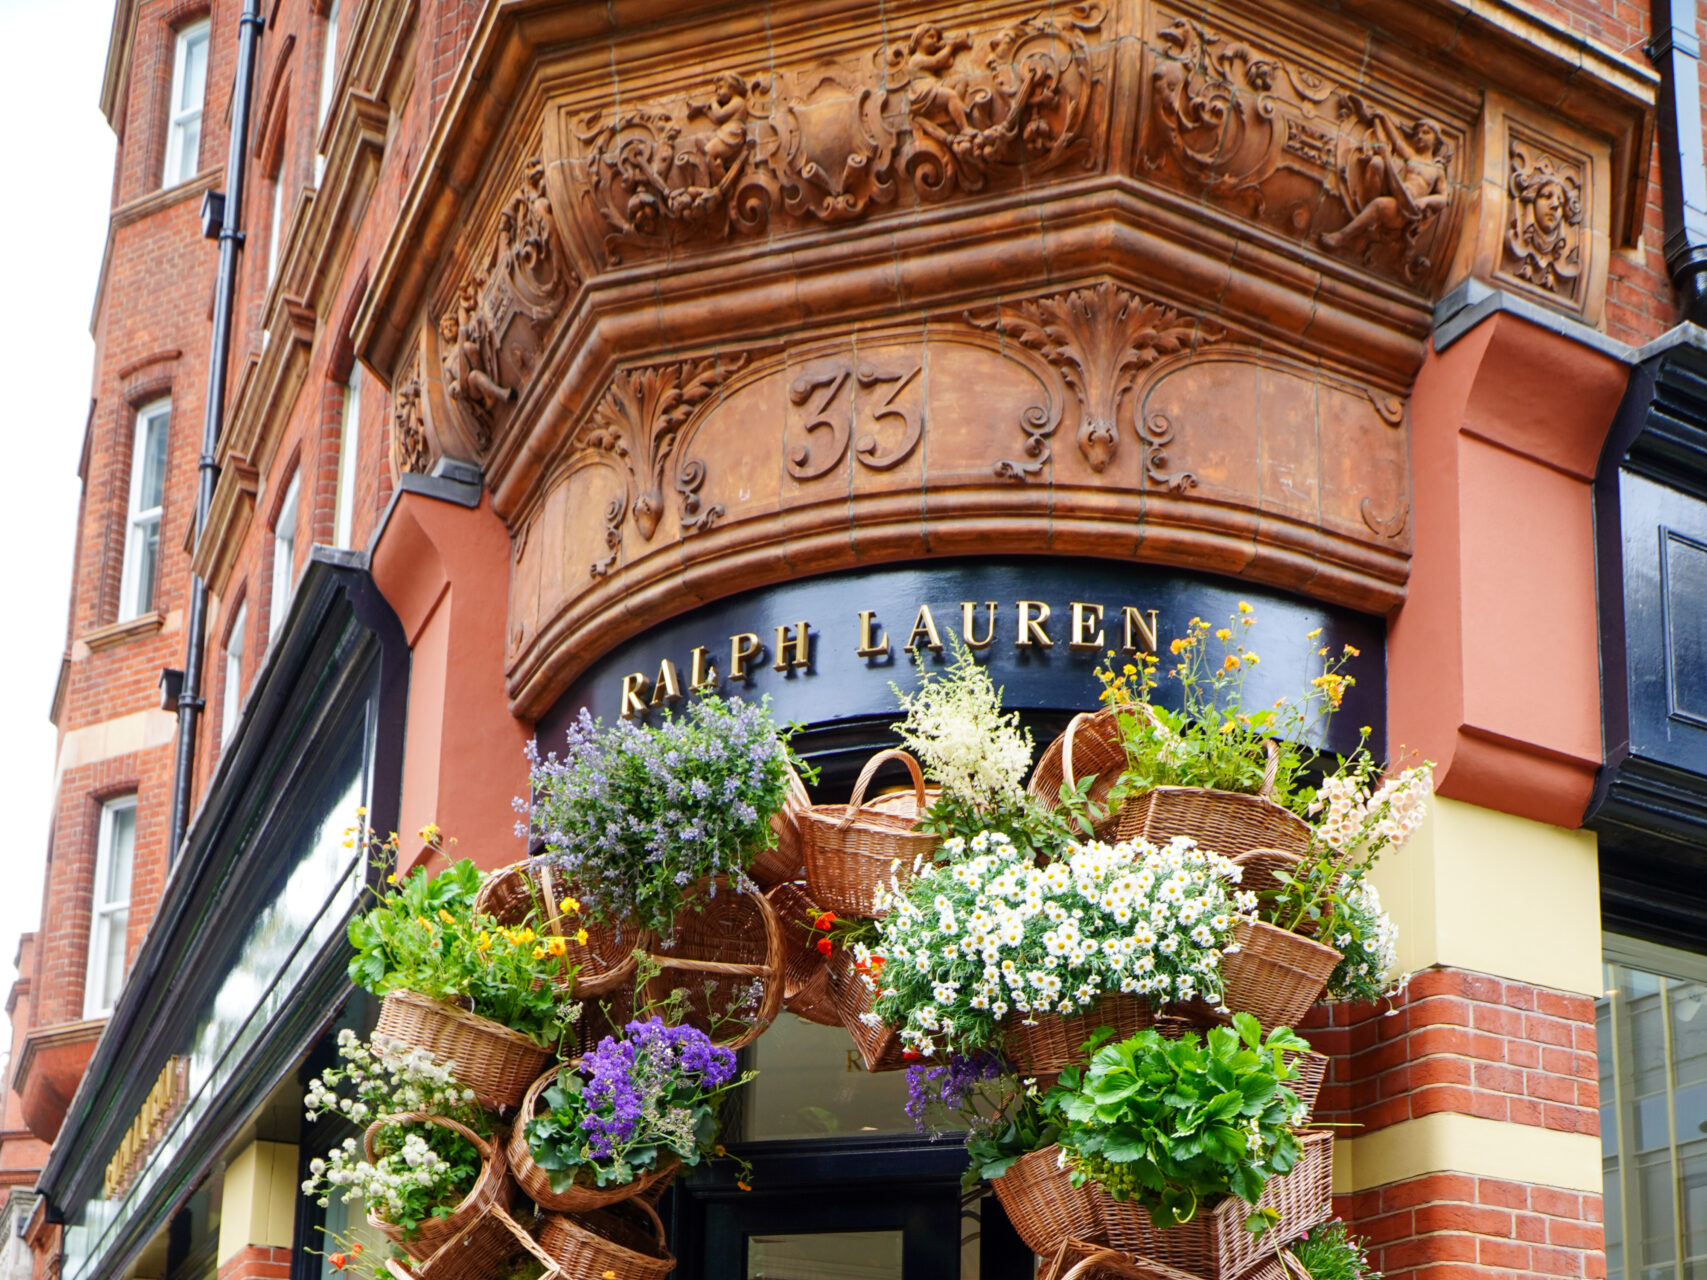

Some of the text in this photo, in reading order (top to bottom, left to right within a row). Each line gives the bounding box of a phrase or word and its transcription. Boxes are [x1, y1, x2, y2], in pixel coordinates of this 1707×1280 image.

[786, 362, 925, 481] 33
[620, 600, 1160, 719] RALPH LAUREN
